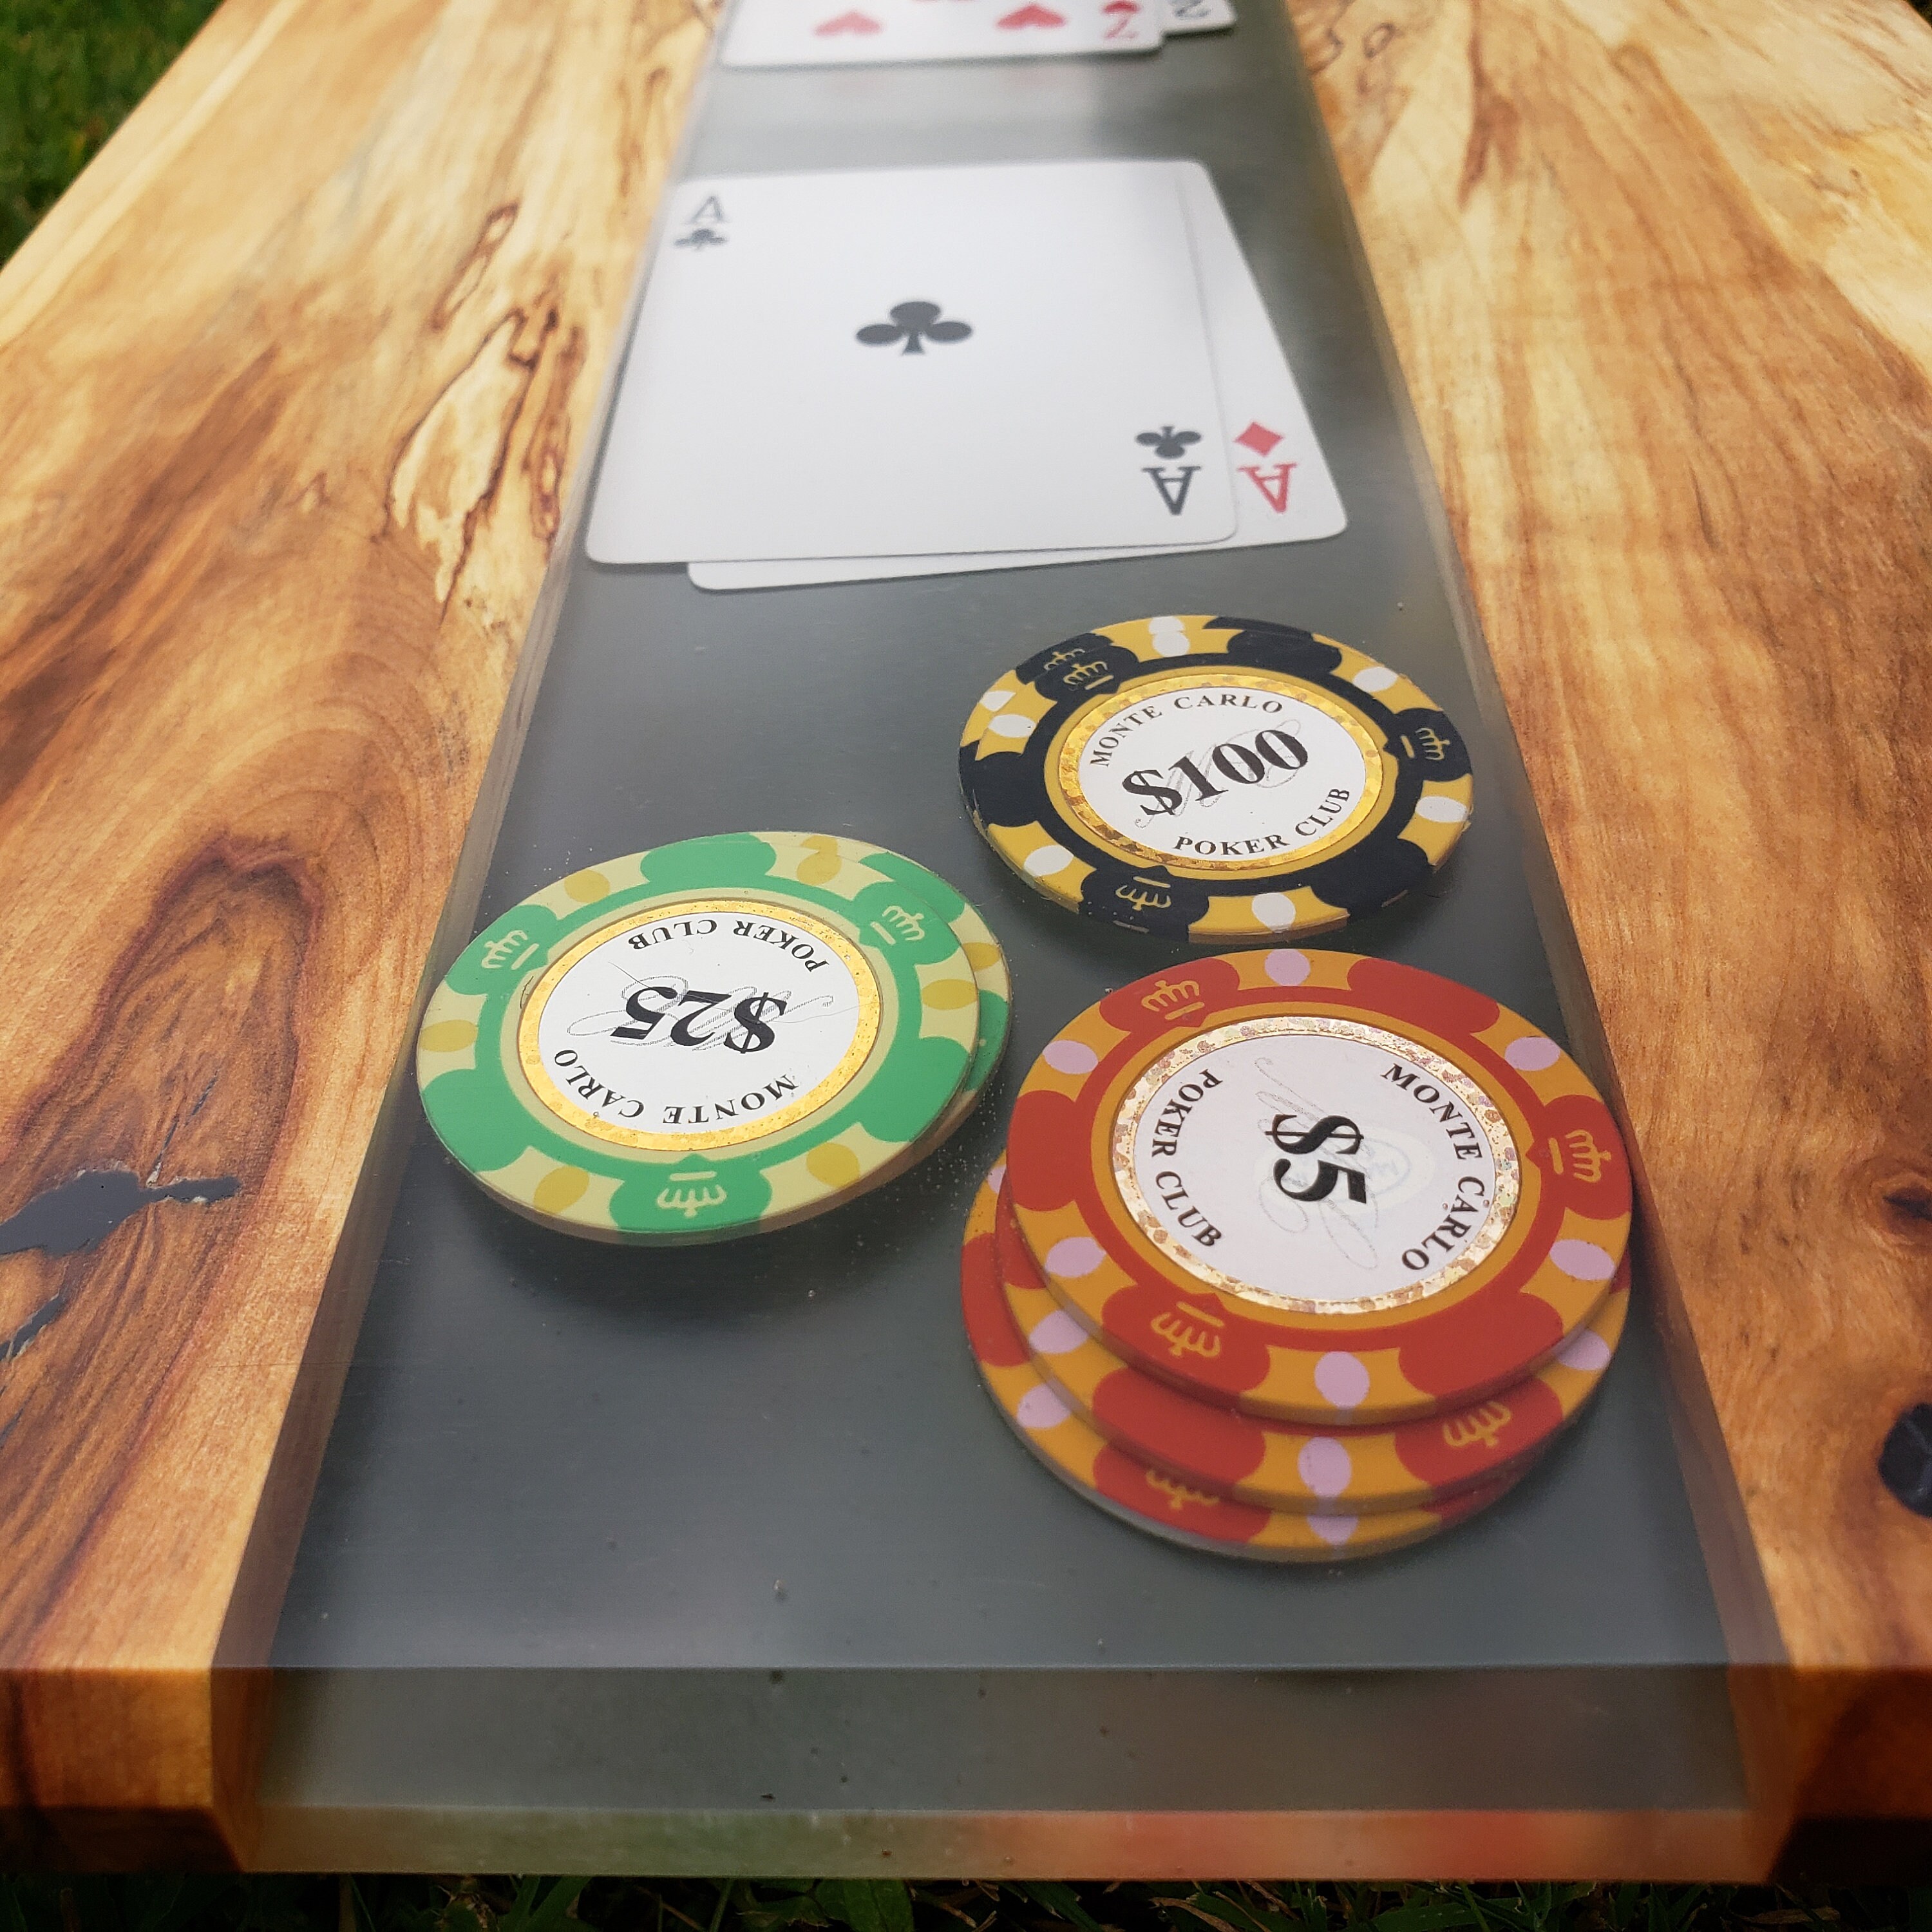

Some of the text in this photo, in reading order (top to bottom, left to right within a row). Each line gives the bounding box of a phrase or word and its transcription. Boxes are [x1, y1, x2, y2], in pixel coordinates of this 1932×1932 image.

[683, 195, 731, 224] A
[1141, 466, 1201, 516] A
[1237, 462, 1298, 513] A
[1090, 693, 1283, 768] MONTE CARLO
[1122, 729, 1309, 817] $100
[1172, 787, 1350, 856] POKER CLUB
[627, 919, 830, 972] POKER CLUB
[609, 985, 788, 1054] $25
[554, 1048, 800, 1125] MONTE CARLO
[1151, 1069, 1223, 1247] POKER CLUB
[1264, 1115, 1367, 1204] $5
[1380, 1063, 1485, 1271] MONTE CARLO
